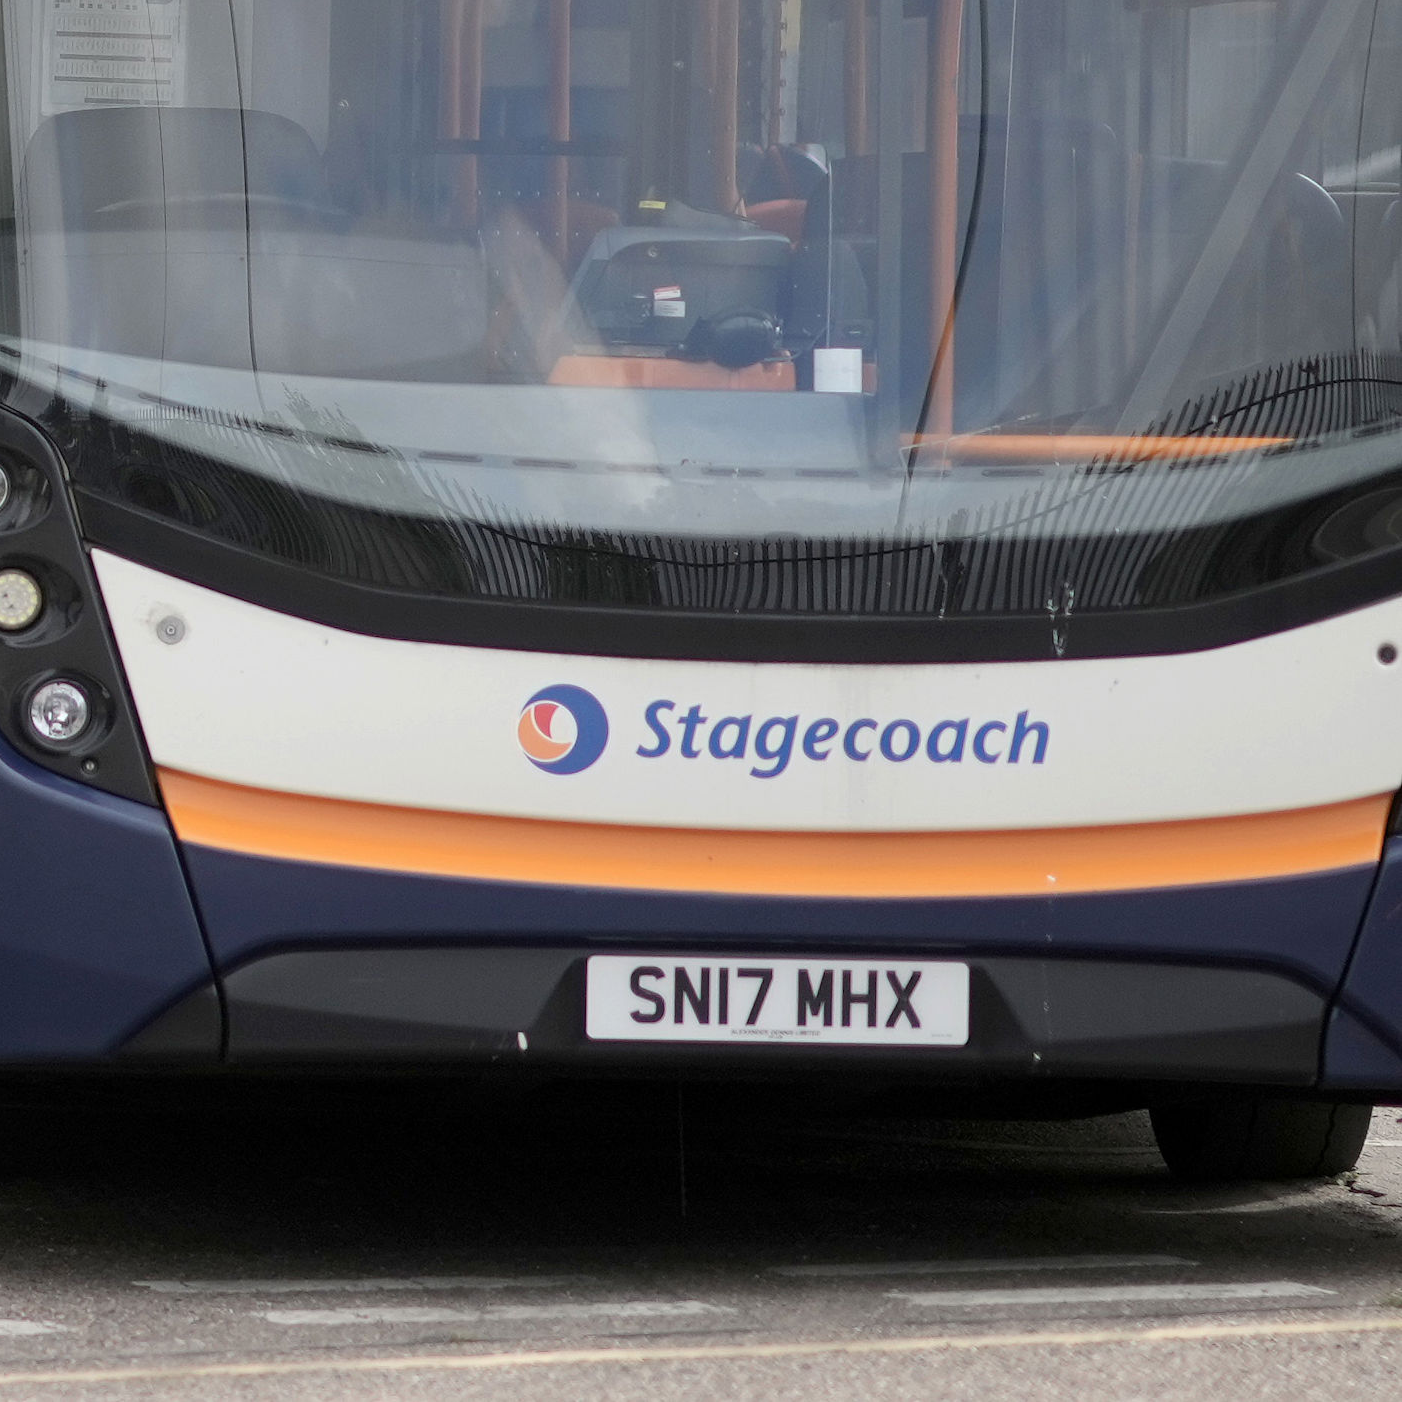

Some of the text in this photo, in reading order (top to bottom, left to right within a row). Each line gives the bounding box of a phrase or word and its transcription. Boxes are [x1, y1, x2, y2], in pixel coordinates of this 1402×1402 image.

[636, 699, 1050, 779] Stagecoach
[629, 965, 922, 1029] SN17 MHX
